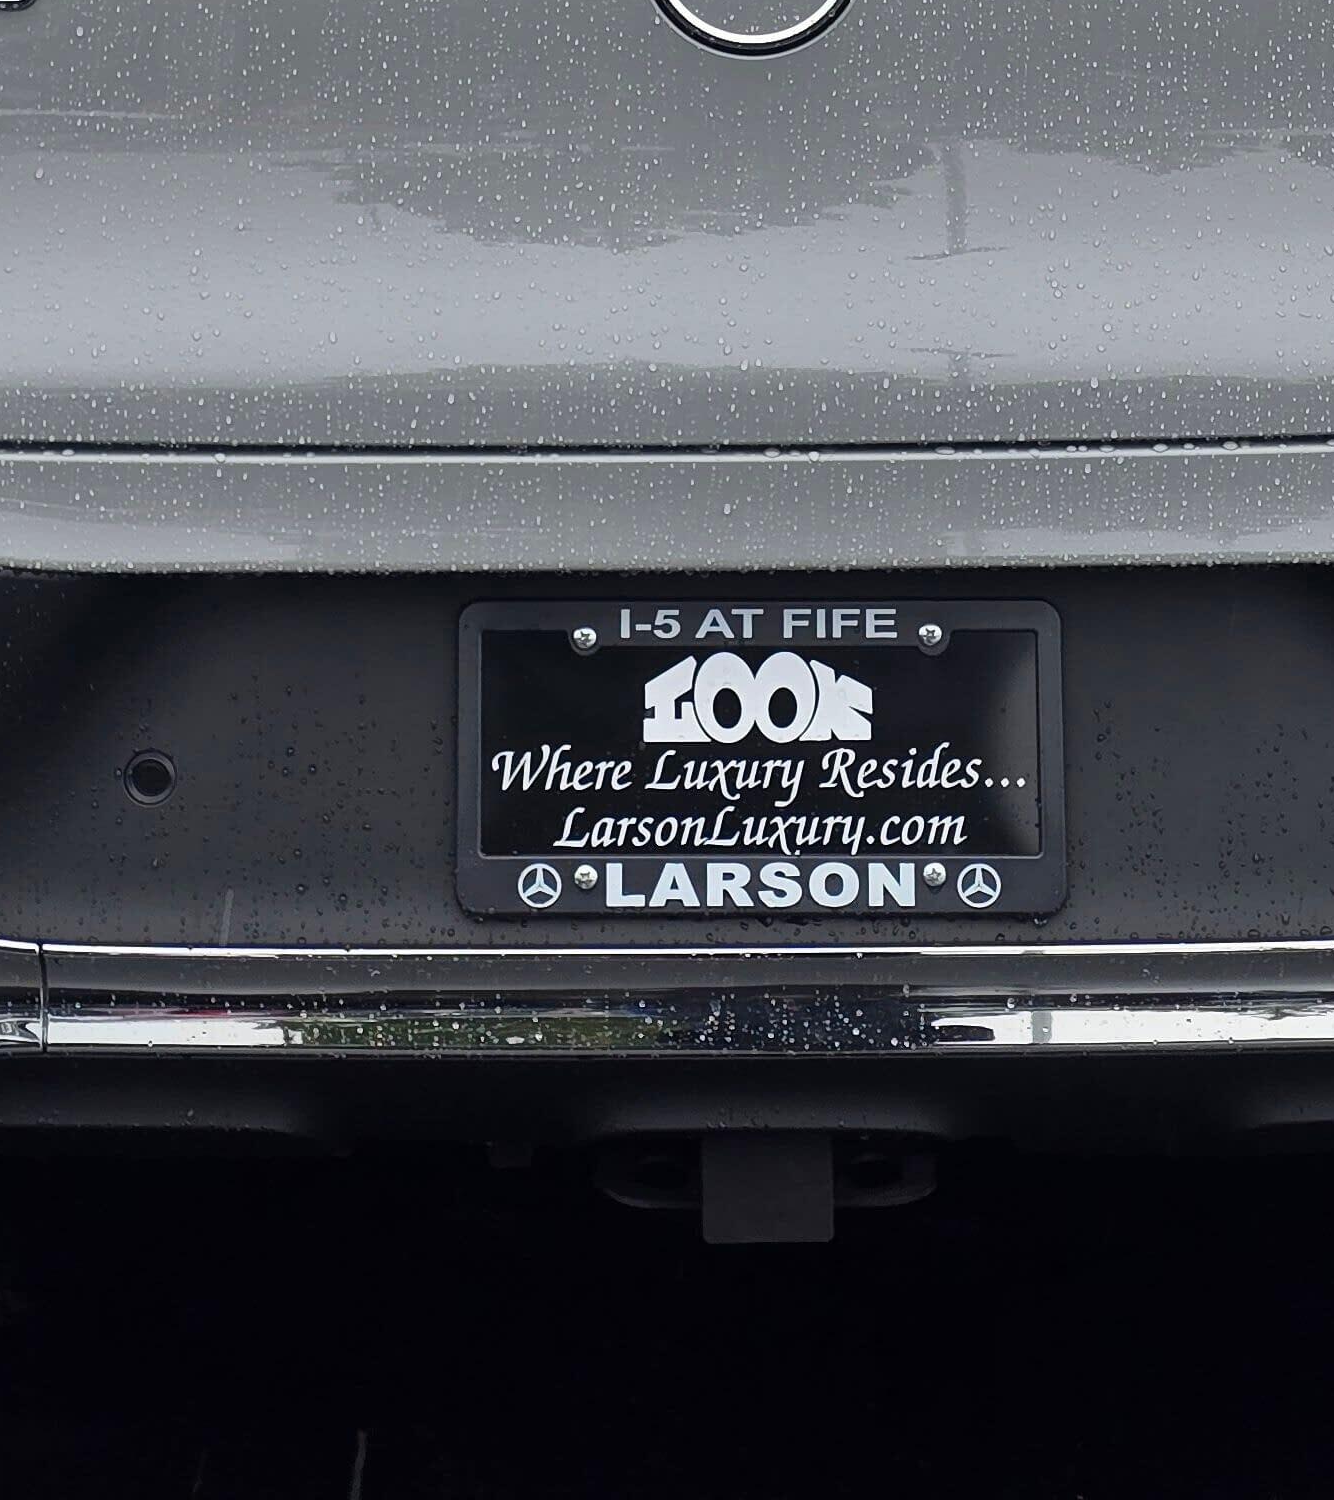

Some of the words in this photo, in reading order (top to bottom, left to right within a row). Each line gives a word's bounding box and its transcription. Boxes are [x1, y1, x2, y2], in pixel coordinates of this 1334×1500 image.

[620, 608, 681, 639] I-5
[695, 608, 764, 639] AT
[782, 608, 898, 639] FIFE
[642, 650, 874, 744] LOOK
[491, 743, 634, 792] Where
[644, 749, 805, 808] Luxury
[818, 741, 1027, 799] Resides...
[552, 805, 968, 856] LarsonLuxury.com
[605, 861, 916, 909] LARSON
